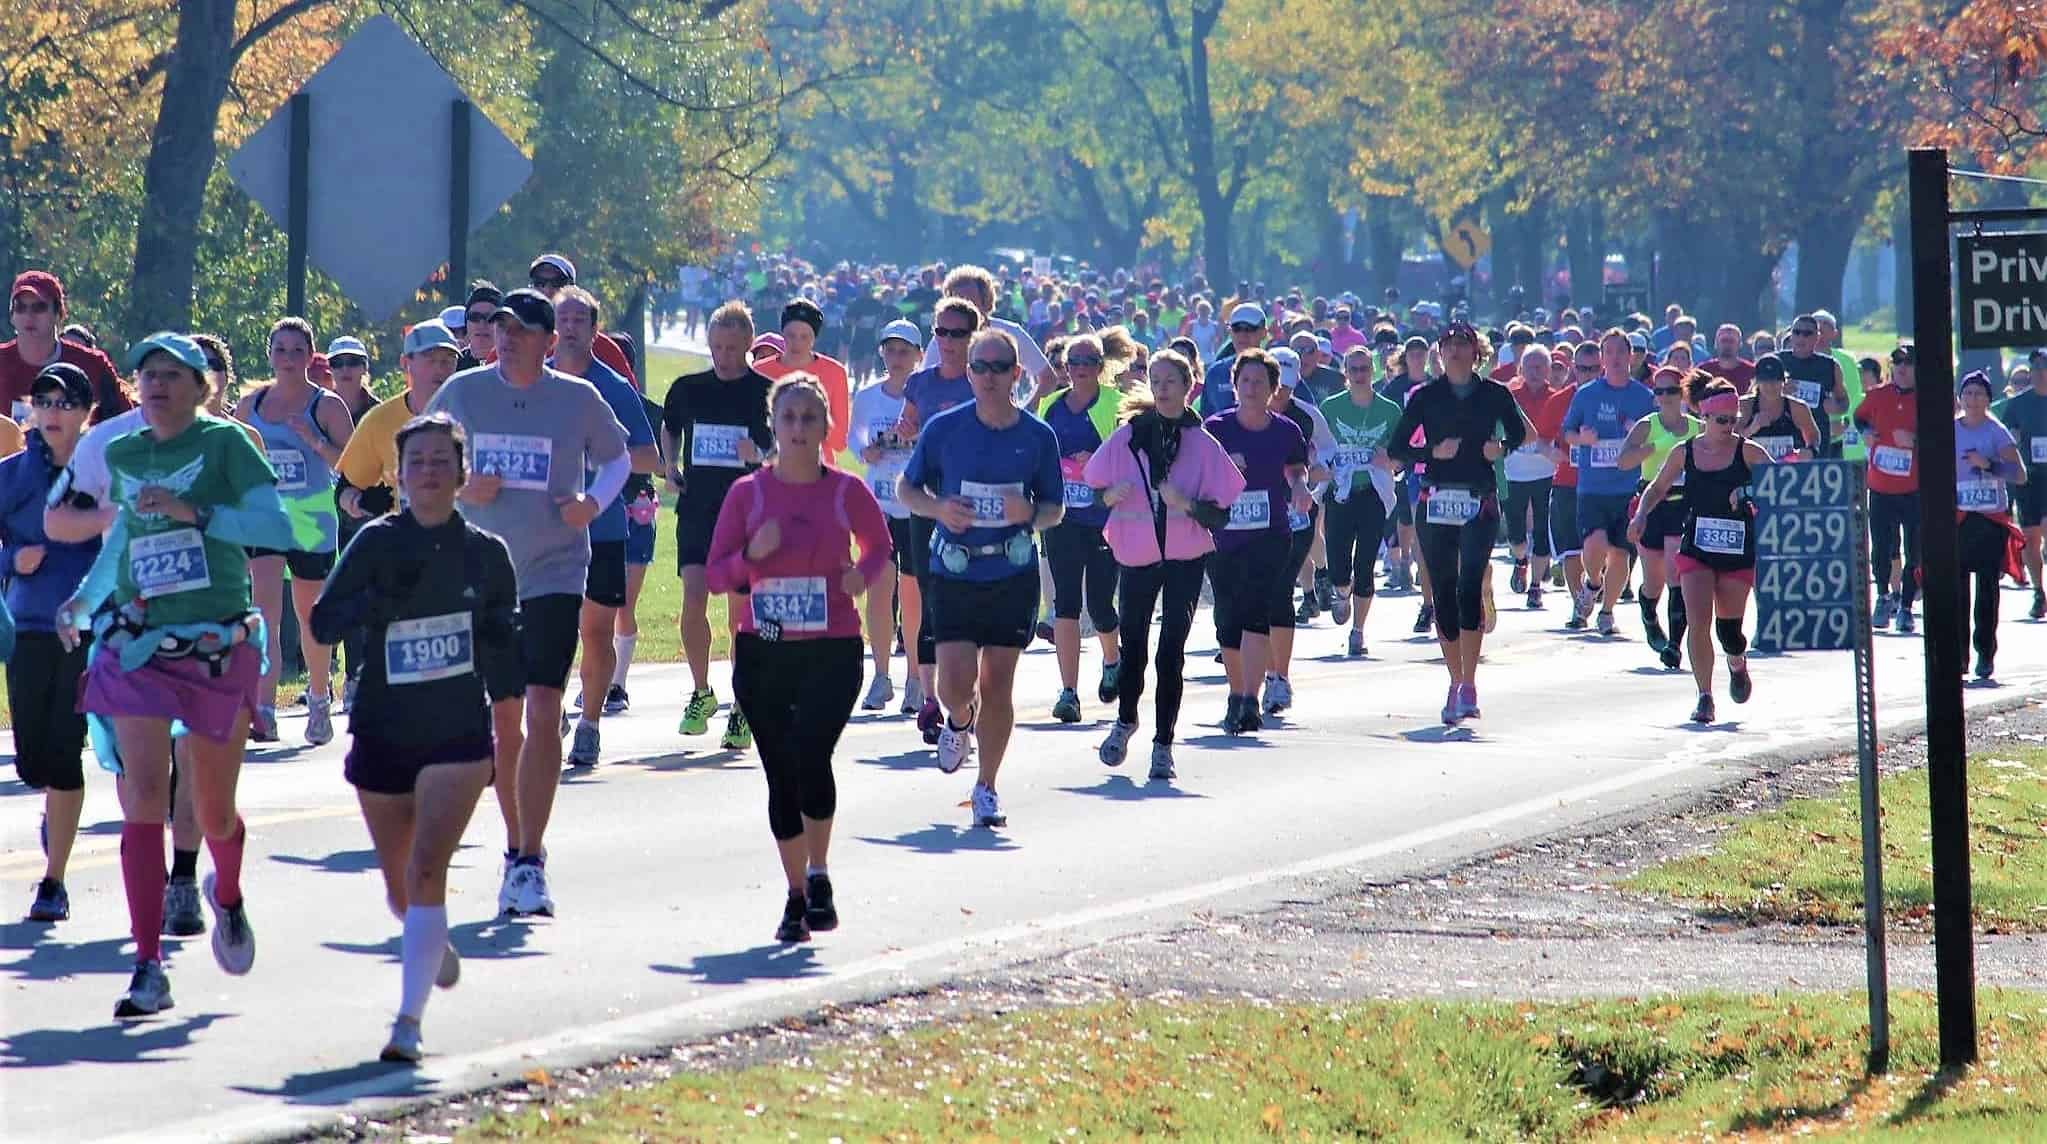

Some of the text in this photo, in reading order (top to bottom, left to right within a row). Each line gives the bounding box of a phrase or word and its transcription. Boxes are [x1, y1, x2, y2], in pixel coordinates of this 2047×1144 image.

[1756, 464, 1843, 506] 4249
[1703, 529, 1737, 543] 3345
[1758, 512, 1845, 553] 4259
[133, 551, 192, 582] 2224
[1759, 559, 1847, 601] 4269
[763, 595, 814, 616] 3347
[1761, 607, 1849, 648] 4279
[401, 635, 459, 664] 1900
